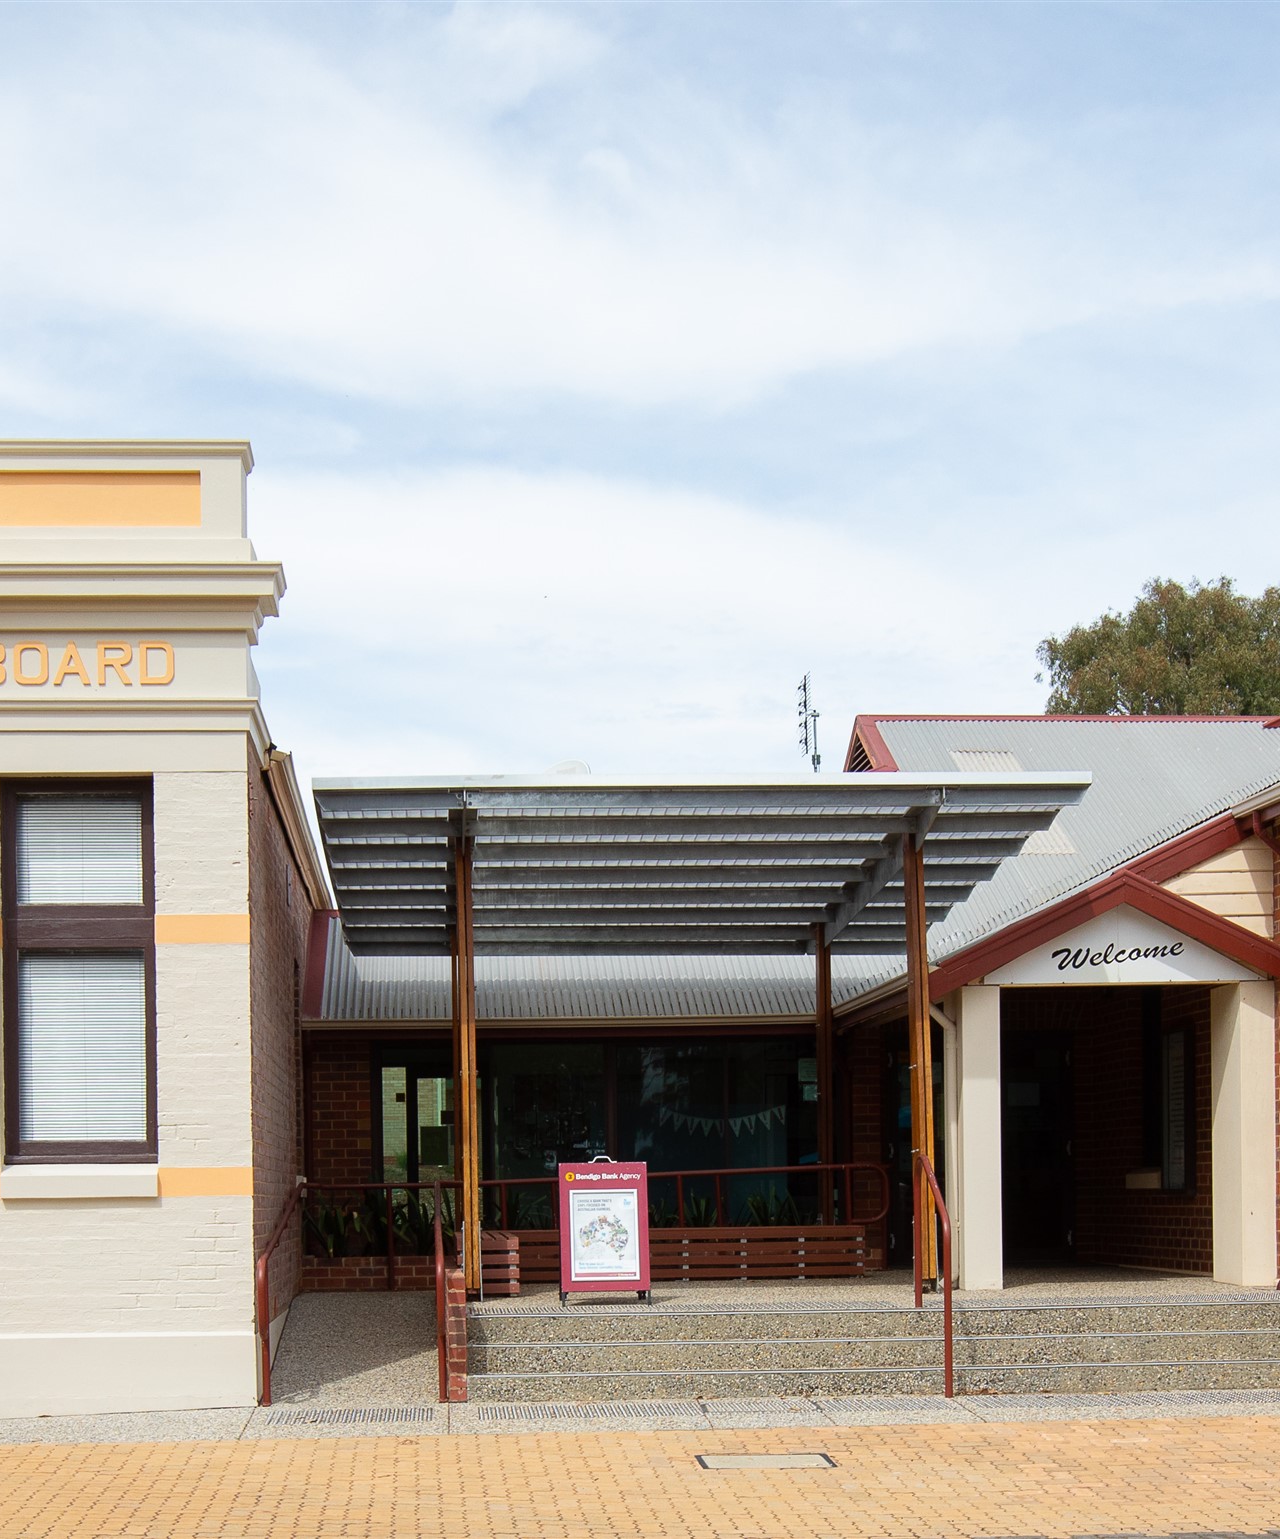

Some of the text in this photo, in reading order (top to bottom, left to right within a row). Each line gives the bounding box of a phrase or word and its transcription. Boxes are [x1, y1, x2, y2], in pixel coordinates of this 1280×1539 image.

[1051, 940, 1185, 972] Welcome
[575, 1173, 601, 1181] Bendigo
[619, 1172, 641, 1180] Agency
